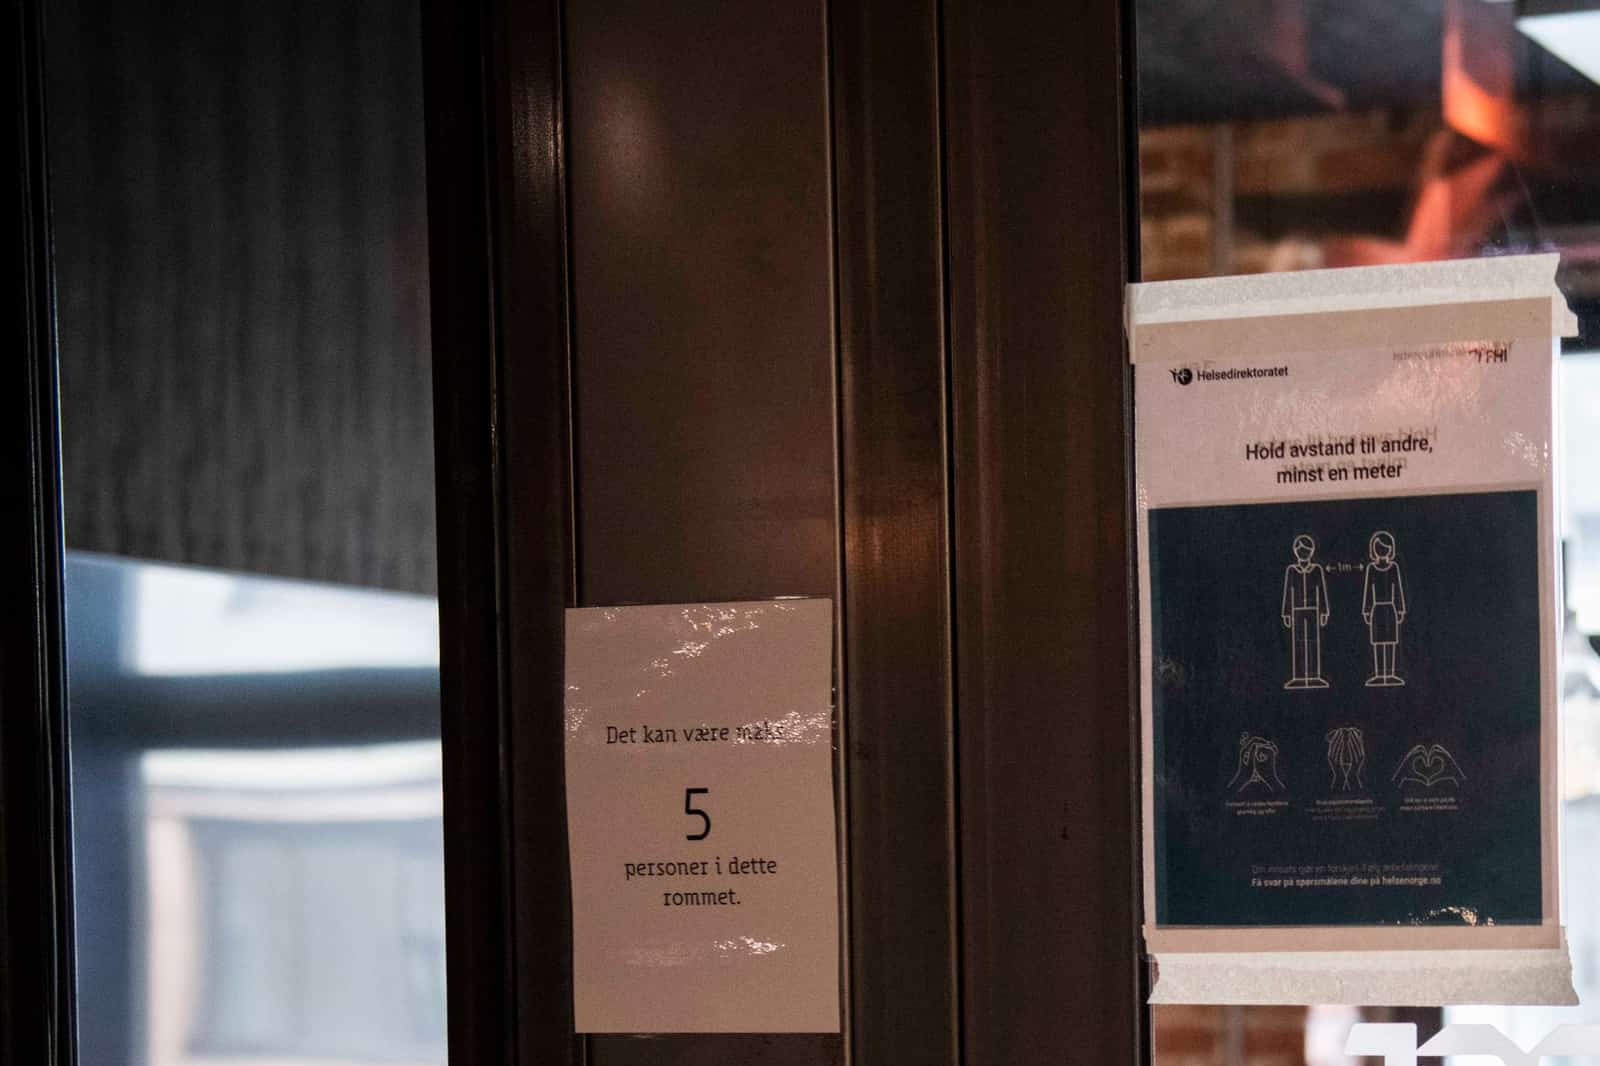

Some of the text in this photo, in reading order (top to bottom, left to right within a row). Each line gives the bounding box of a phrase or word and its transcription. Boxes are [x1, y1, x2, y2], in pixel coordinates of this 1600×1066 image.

[1197, 364, 1289, 381] Helsedirektoratet
[1246, 441, 1285, 461] Hold
[1290, 438, 1355, 458] avstand
[1360, 437, 1376, 454] til
[1381, 434, 1433, 453] andre,
[1277, 464, 1403, 484] minst en meter
[606, 721, 786, 744] Det kan være maks
[684, 788, 711, 841] 5
[624, 856, 777, 880] personer i dette
[664, 888, 741, 906] rommet.
